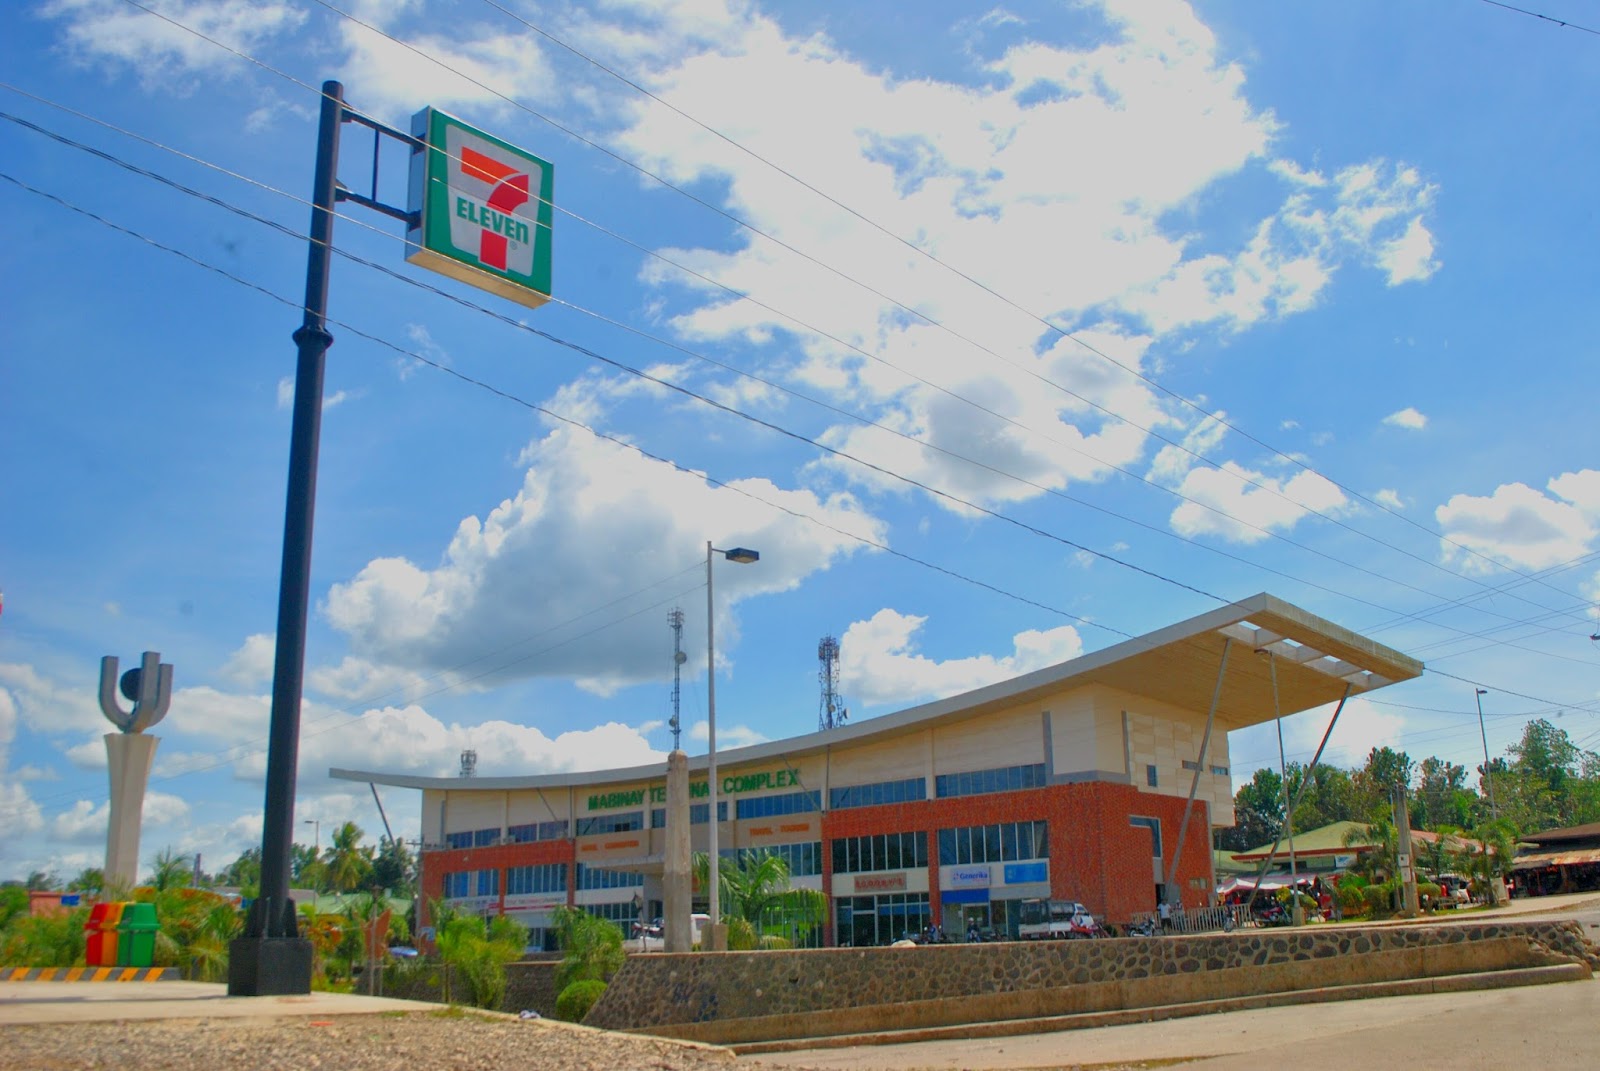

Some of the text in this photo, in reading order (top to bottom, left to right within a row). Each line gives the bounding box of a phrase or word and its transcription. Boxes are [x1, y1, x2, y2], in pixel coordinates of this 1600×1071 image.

[461, 146, 529, 271] 7
[588, 769, 799, 811] MABINAY TEINA COMPLEX
[960, 871, 988, 879] Generika
